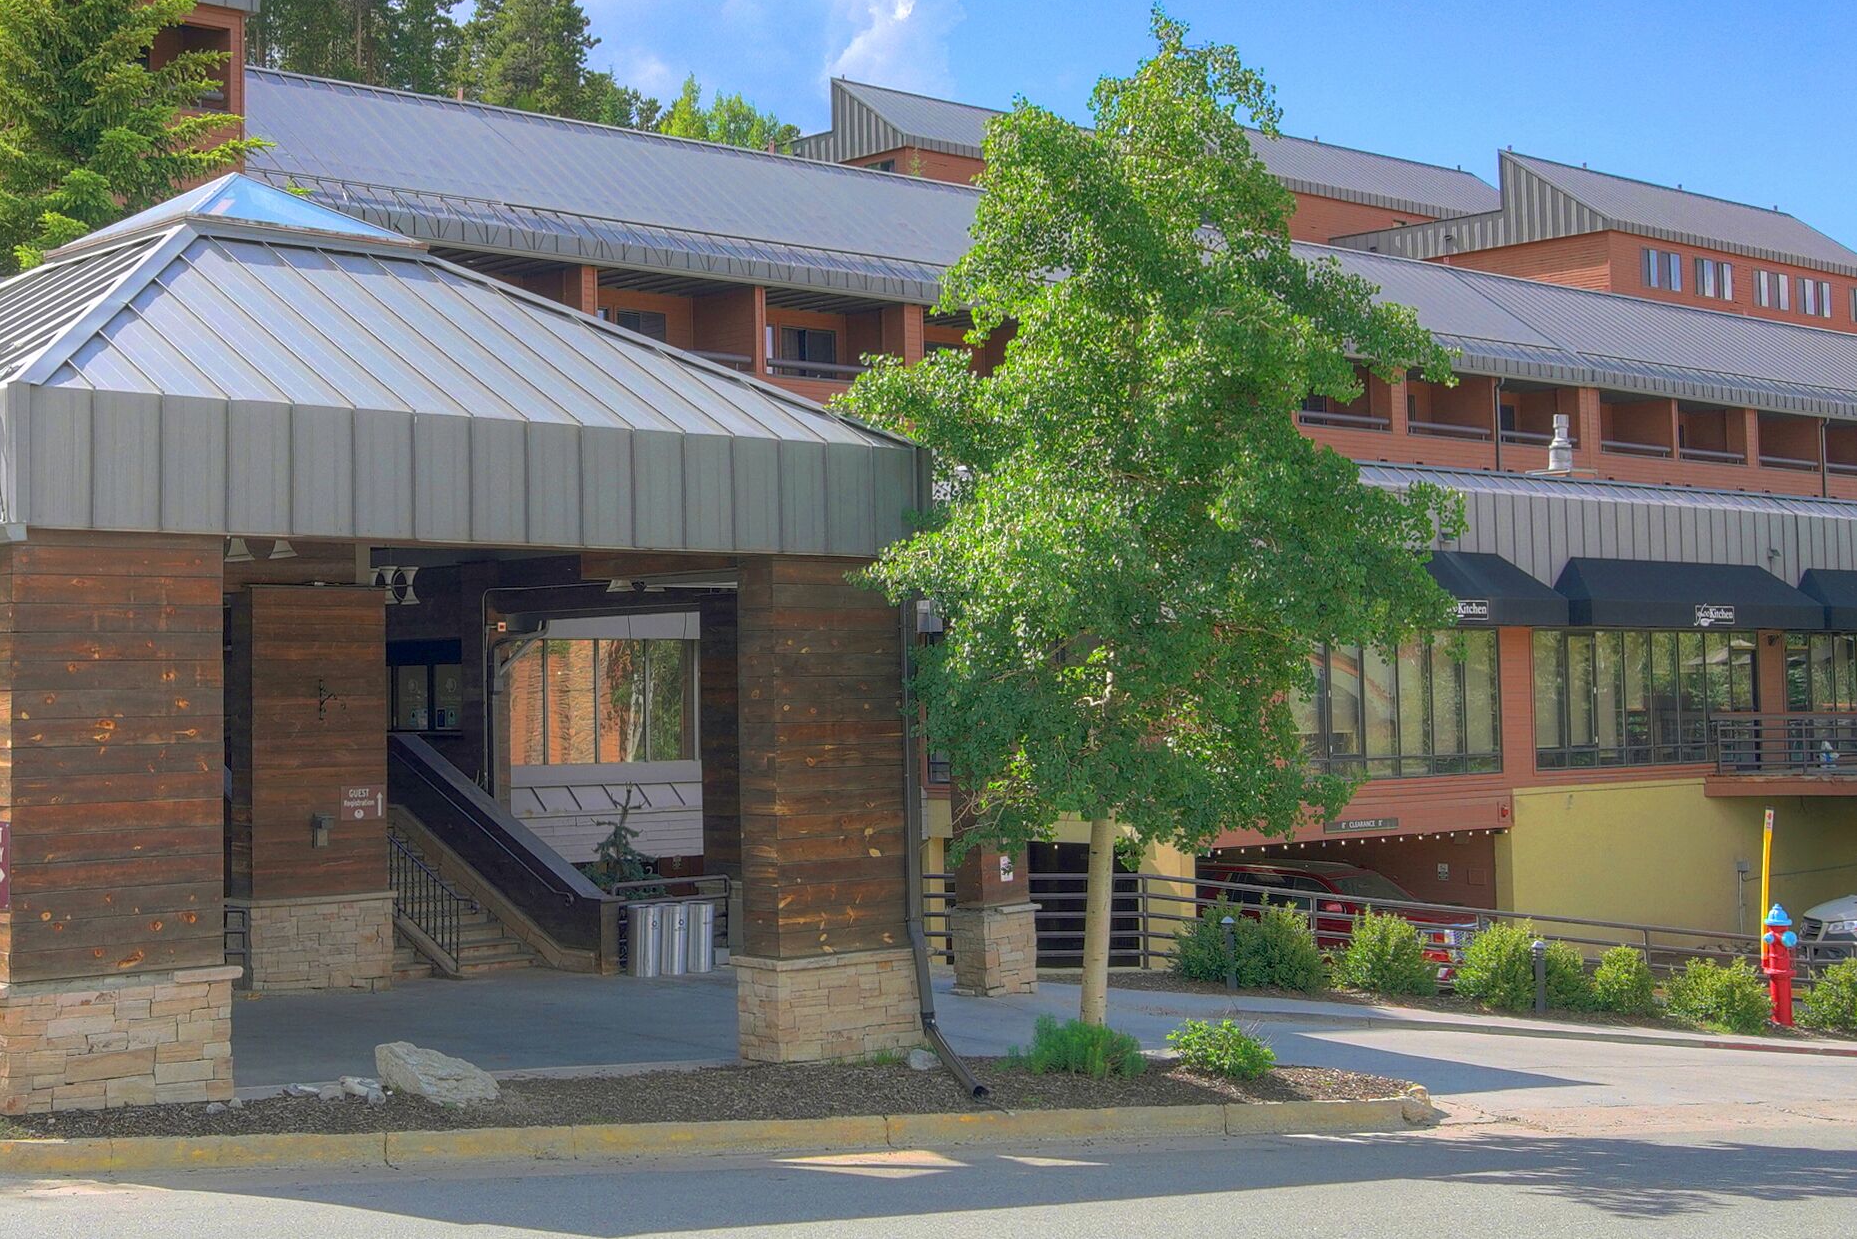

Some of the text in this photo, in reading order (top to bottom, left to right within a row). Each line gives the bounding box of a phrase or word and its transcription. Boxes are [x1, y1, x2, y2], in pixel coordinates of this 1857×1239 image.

[348, 788, 369, 798] GUEST
[344, 799, 375, 808] Registration
[1349, 820, 1376, 829] CLEARANCE
